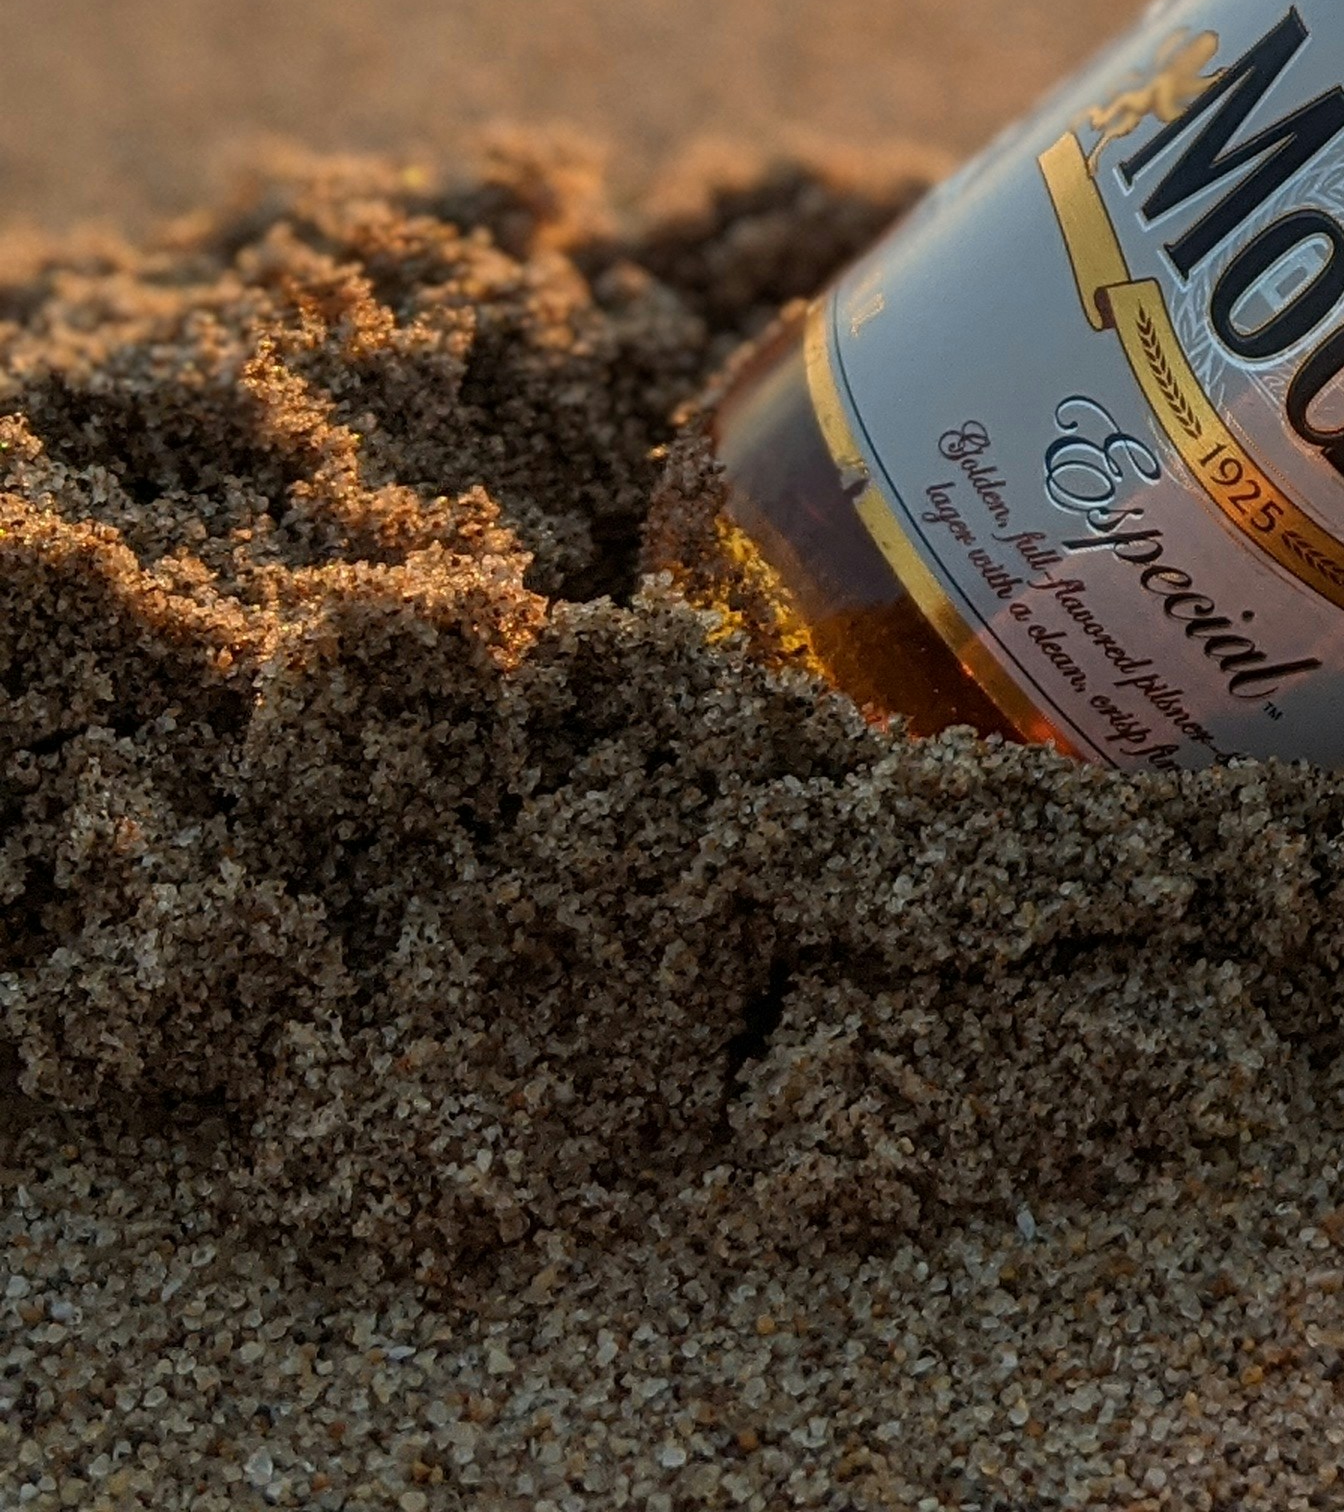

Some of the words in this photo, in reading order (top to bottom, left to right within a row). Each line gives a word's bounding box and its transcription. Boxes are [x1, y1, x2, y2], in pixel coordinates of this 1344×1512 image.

[922, 482, 977, 547] lager
[967, 546, 1025, 601] with
[1009, 602, 1034, 623] a
[1027, 615, 1088, 695] clean,
[1089, 690, 1159, 747] crisp
[938, 420, 1010, 528] Golden,
[993, 531, 1154, 675] full-flavored
[1044, 395, 1322, 699] Especial
[1199, 442, 1285, 534] 1925
